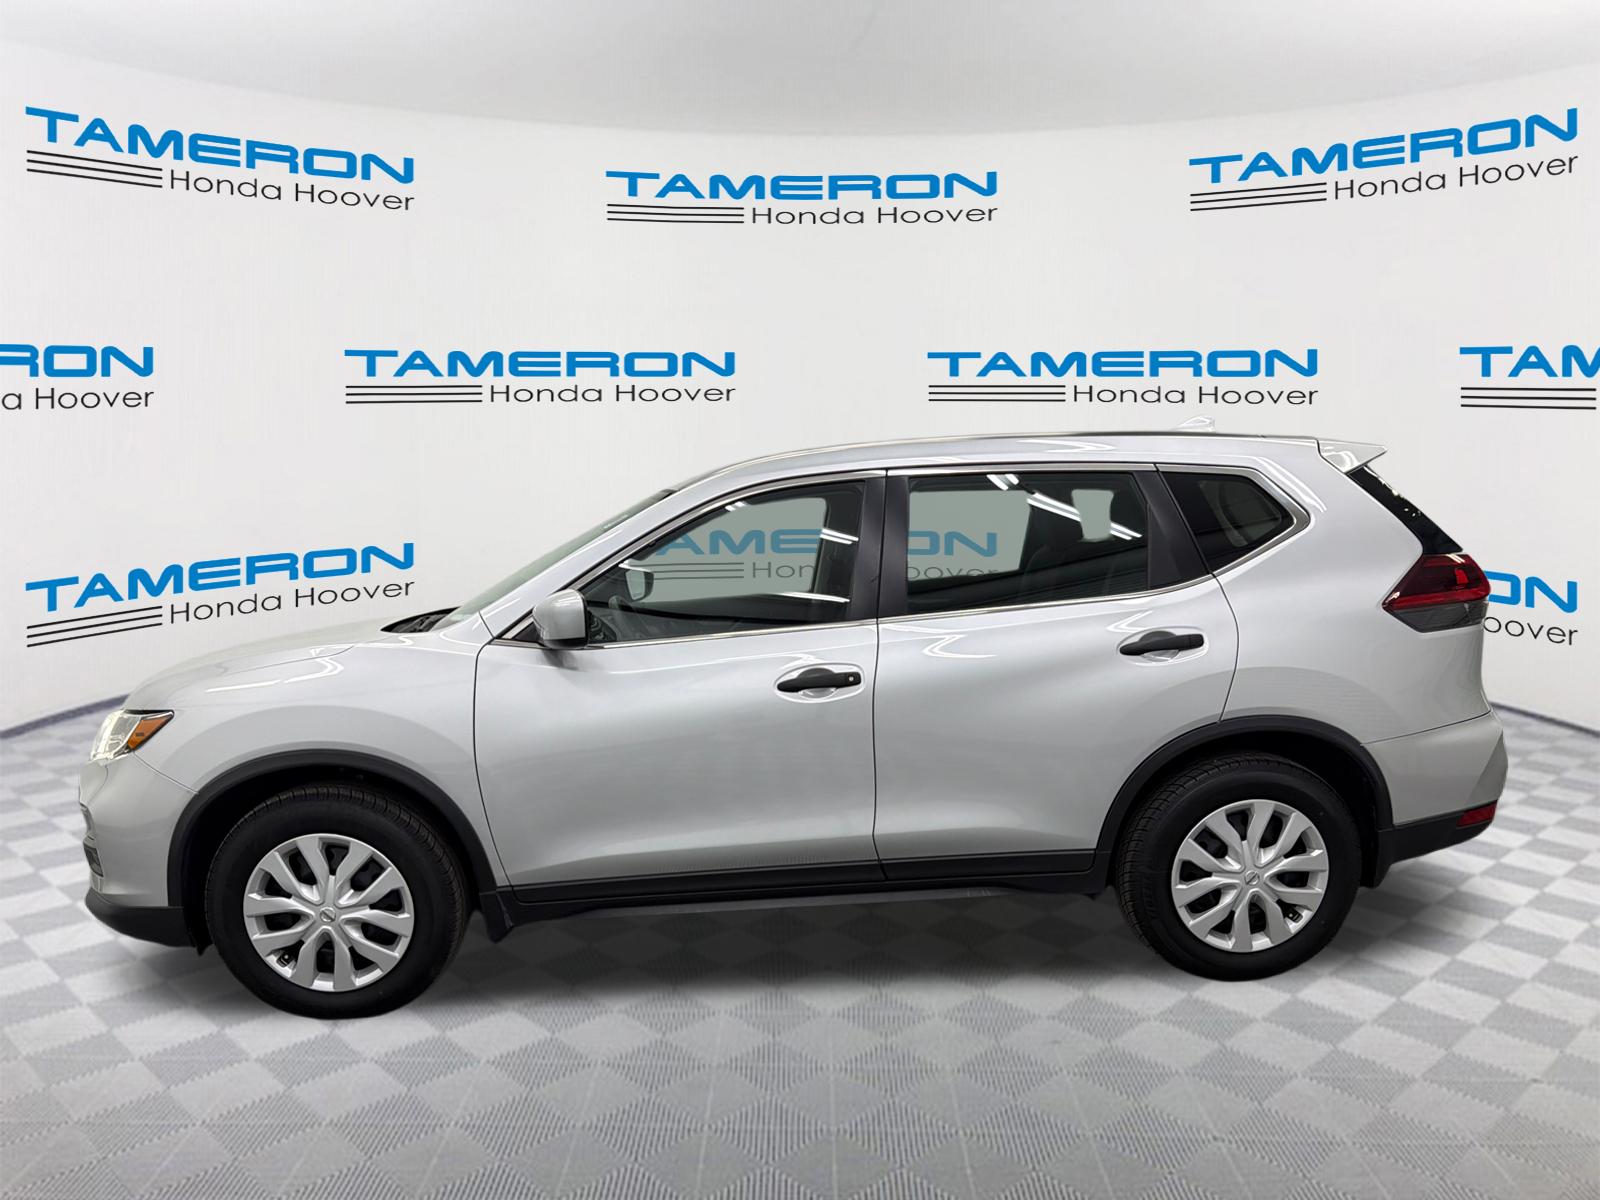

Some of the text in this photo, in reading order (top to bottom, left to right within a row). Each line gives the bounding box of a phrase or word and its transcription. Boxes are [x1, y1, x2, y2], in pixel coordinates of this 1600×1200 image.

[25, 106, 415, 185] TAMERON
[1188, 107, 1579, 185] TAMERON
[170, 169, 415, 211] Honda Hoover
[605, 170, 998, 201] TAMERON
[1334, 155, 1579, 200] Honda Hoover
[752, 206, 998, 225] Honda Hoover
[0, 343, 155, 378] RON
[344, 349, 737, 379] TAMERON
[927, 349, 1319, 379] TAMERON
[1458, 343, 1600, 379] TAM
[35, 387, 155, 410] Hoover
[490, 384, 736, 403] Honda Hoover
[1073, 384, 1319, 405] Honda Hoover
[25, 542, 415, 613] TAMERON
[170, 581, 415, 625] Honda Hoover
[1482, 616, 1579, 646] oover
